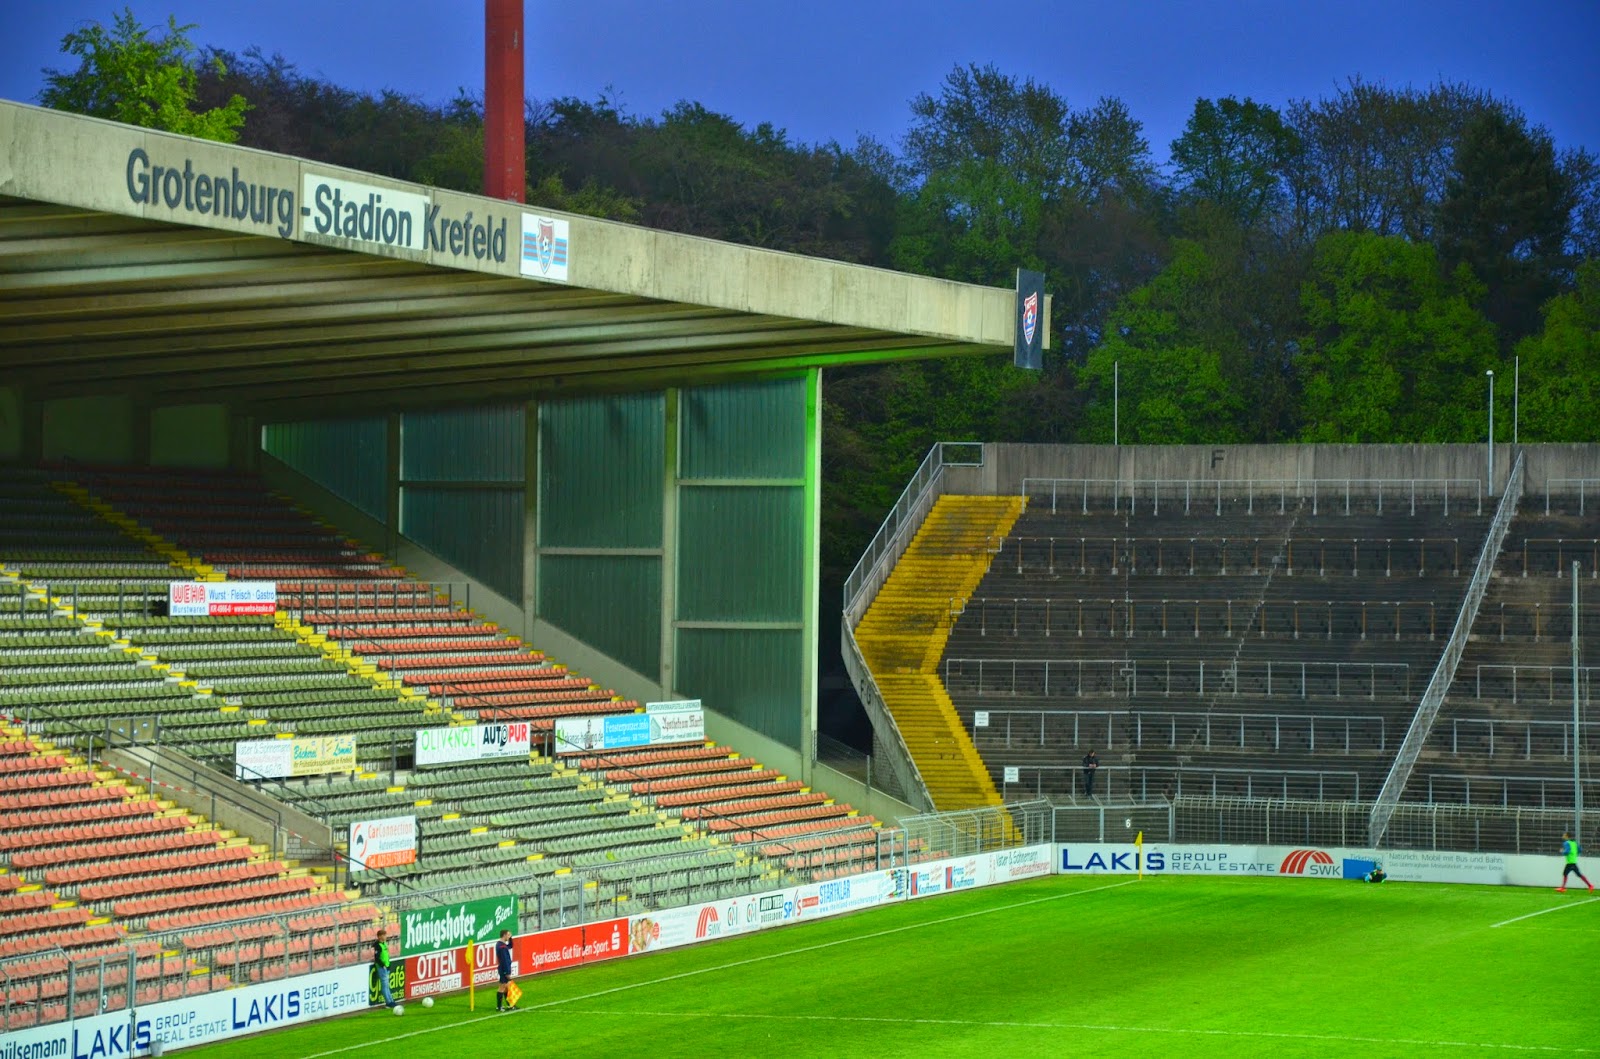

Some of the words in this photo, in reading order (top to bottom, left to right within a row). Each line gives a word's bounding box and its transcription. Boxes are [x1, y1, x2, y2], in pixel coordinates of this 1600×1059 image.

[126, 148, 294, 239] Grotenburg
[424, 201, 507, 262] Krefeld
[1211, 450, 1225, 468] F
[172, 584, 206, 604] WEHA
[209, 589, 226, 600] Wurst
[230, 590, 251, 600] Fleisch
[256, 590, 274, 600] Gastro
[1063, 848, 1164, 870] LAKIS
[1172, 853, 1227, 861] GROUP
[1172, 862, 1214, 871] REAL
[1219, 862, 1275, 872] ESTATE
[1455, 854, 1468, 863] Bus
[1470, 855, 1484, 863] und
[1310, 864, 1341, 876] SWK
[820, 880, 850, 904] STARTKLAR
[405, 905, 476, 948] Königshofer
[562, 946, 572, 960] Gut
[573, 944, 581, 957] für
[593, 940, 610, 956] Sport.
[417, 950, 456, 979] OTTEN
[304, 982, 339, 1000] GROUP
[411, 982, 440, 996] MENSWEAR
[232, 990, 300, 1030] LAKIS
[304, 998, 330, 1014] REAL
[332, 991, 367, 1008] ESTATE
[156, 1011, 196, 1030] GROUP
[74, 1020, 150, 1059] LAKIS
[156, 1024, 186, 1043] REAL
[190, 1019, 227, 1040] ESTATE
